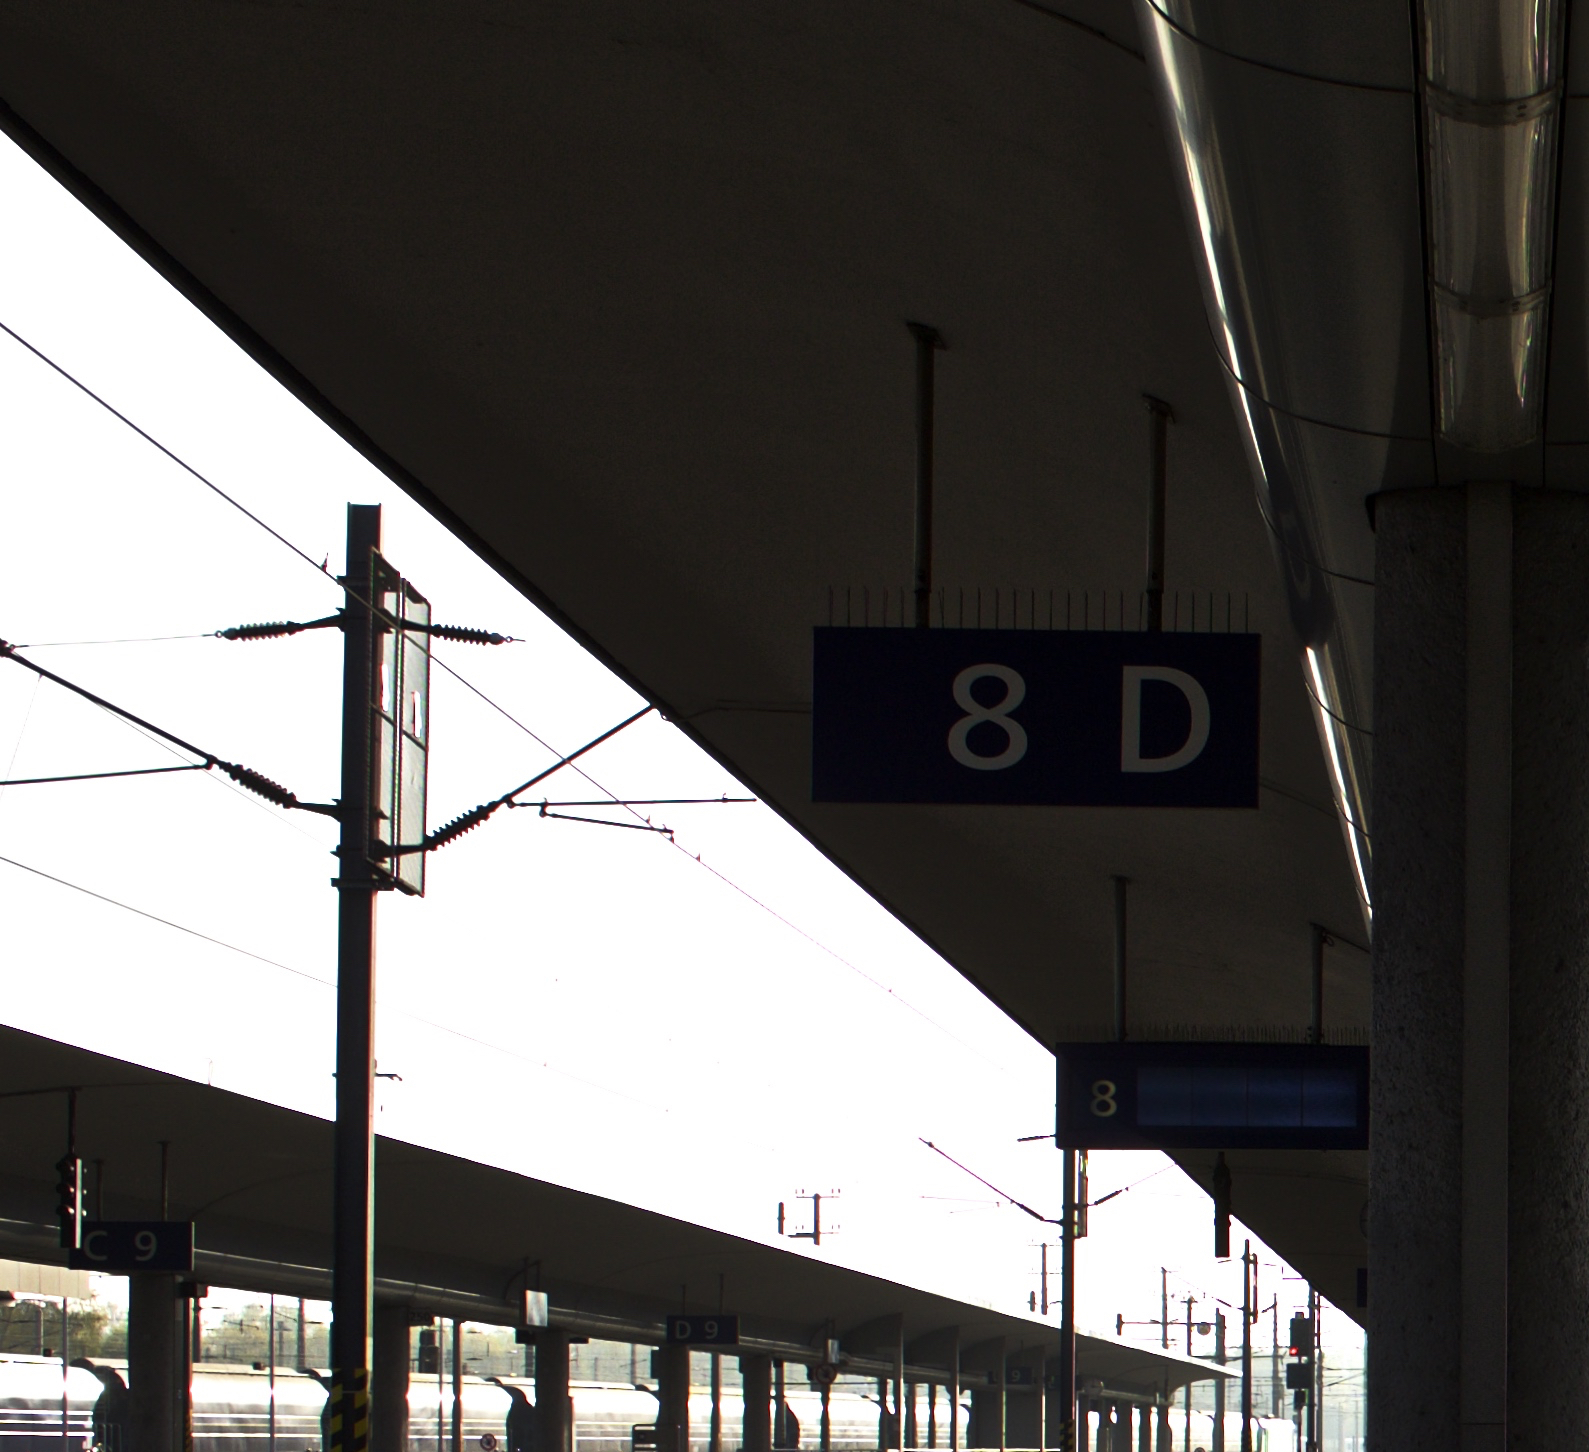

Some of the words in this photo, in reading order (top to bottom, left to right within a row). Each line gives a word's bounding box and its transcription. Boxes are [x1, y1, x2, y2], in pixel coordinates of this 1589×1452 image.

[947, 662, 1029, 772] 8
[1120, 664, 1212, 774] D
[1090, 1079, 1118, 1118] 8
[83, 1229, 109, 1262] C
[134, 1230, 158, 1262] 9
[675, 1320, 692, 1340] D
[704, 1320, 719, 1340] 9
